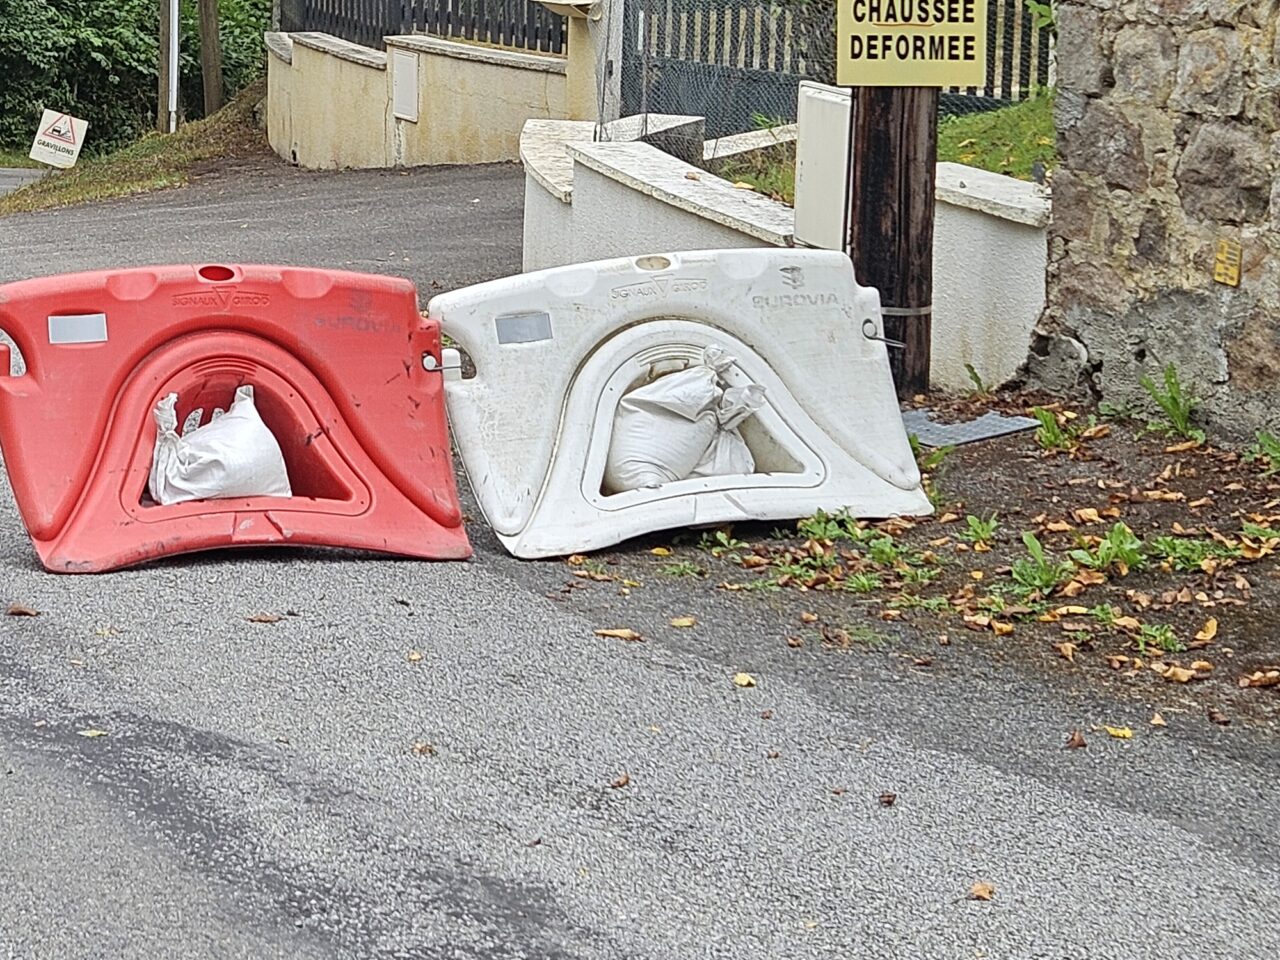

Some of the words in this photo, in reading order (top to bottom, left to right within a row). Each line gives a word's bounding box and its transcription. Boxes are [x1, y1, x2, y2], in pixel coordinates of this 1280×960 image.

[850, 35, 975, 60] DEFORMEE
[37, 140, 74, 156] GRAVILLONS
[752, 292, 839, 308] EUROVIA
